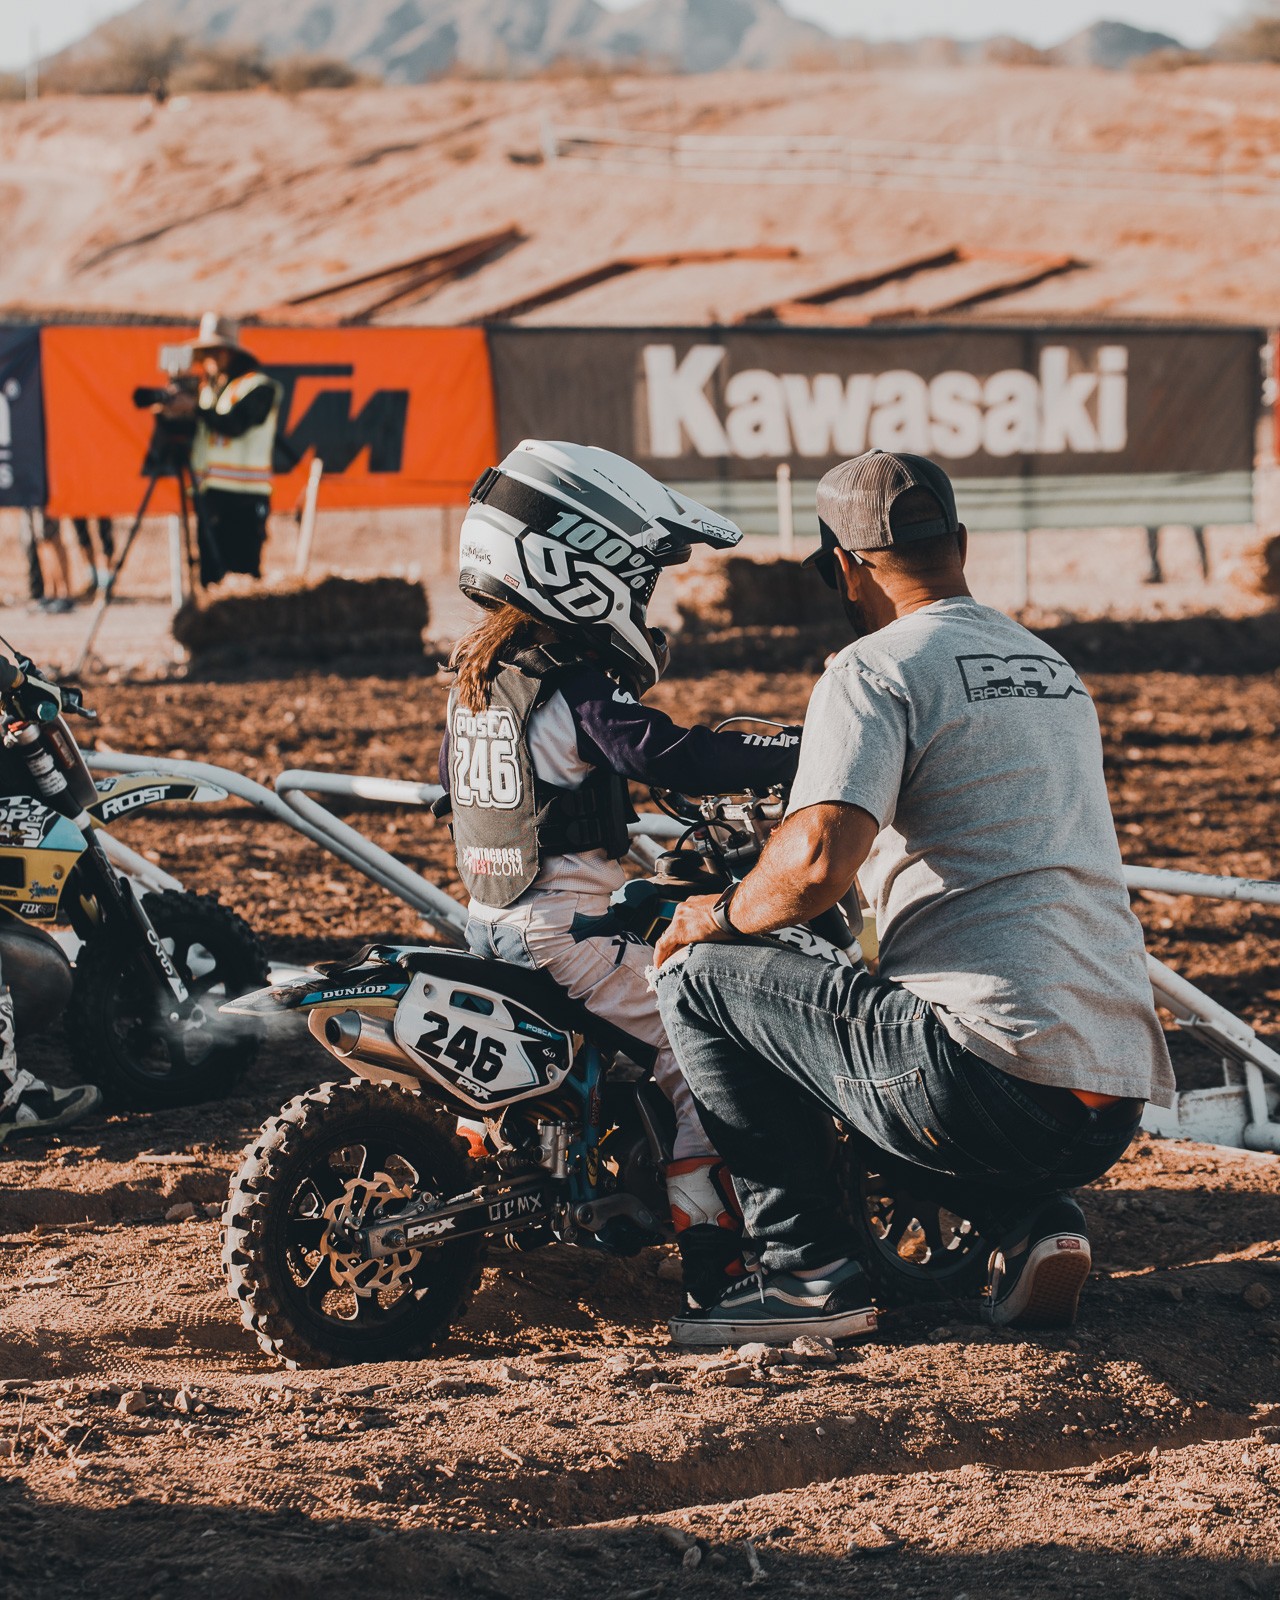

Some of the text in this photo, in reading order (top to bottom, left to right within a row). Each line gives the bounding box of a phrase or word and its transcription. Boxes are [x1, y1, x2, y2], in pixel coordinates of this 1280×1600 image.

[640, 344, 1129, 458] Kawasaki
[546, 511, 655, 590] 100%
[955, 654, 1090, 700] PAX
[970, 686, 1039, 701] RACING
[456, 715, 515, 740] POSCA
[456, 737, 519, 804] 246
[101, 785, 171, 820] ROOST
[322, 985, 388, 999] DUNLOP
[414, 1010, 507, 1083] 246
